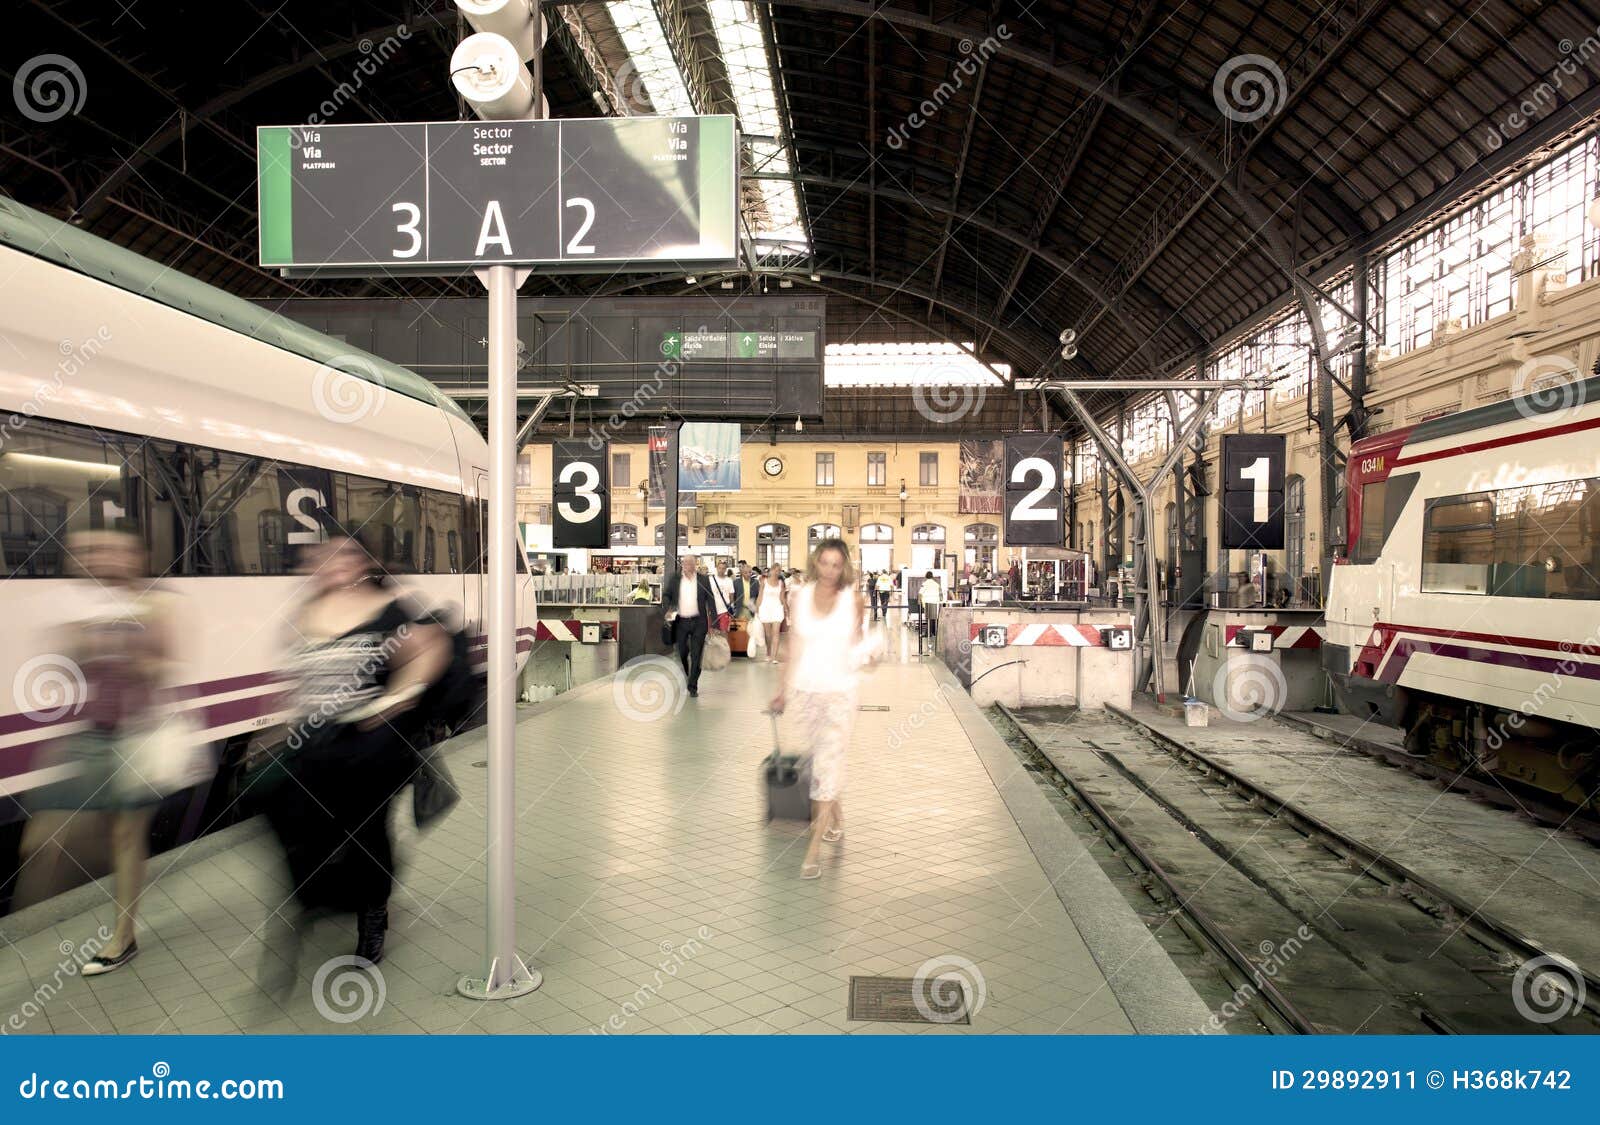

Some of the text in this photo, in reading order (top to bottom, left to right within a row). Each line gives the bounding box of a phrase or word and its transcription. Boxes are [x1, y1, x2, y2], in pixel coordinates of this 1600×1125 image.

[473, 127, 513, 140] Sector
[669, 121, 687, 133] Vía
[302, 130, 321, 143] Vía
[473, 143, 514, 156] Sector
[652, 153, 688, 161] PLATFORM
[302, 162, 336, 170] PLATFORM
[480, 157, 506, 166] SECTOR
[392, 202, 422, 258] 3
[475, 200, 513, 256] A
[566, 197, 596, 255] 2
[1361, 455, 1385, 474] 034M
[557, 461, 602, 524] 3
[1010, 456, 1058, 521] 2
[1240, 457, 1270, 523] 1
